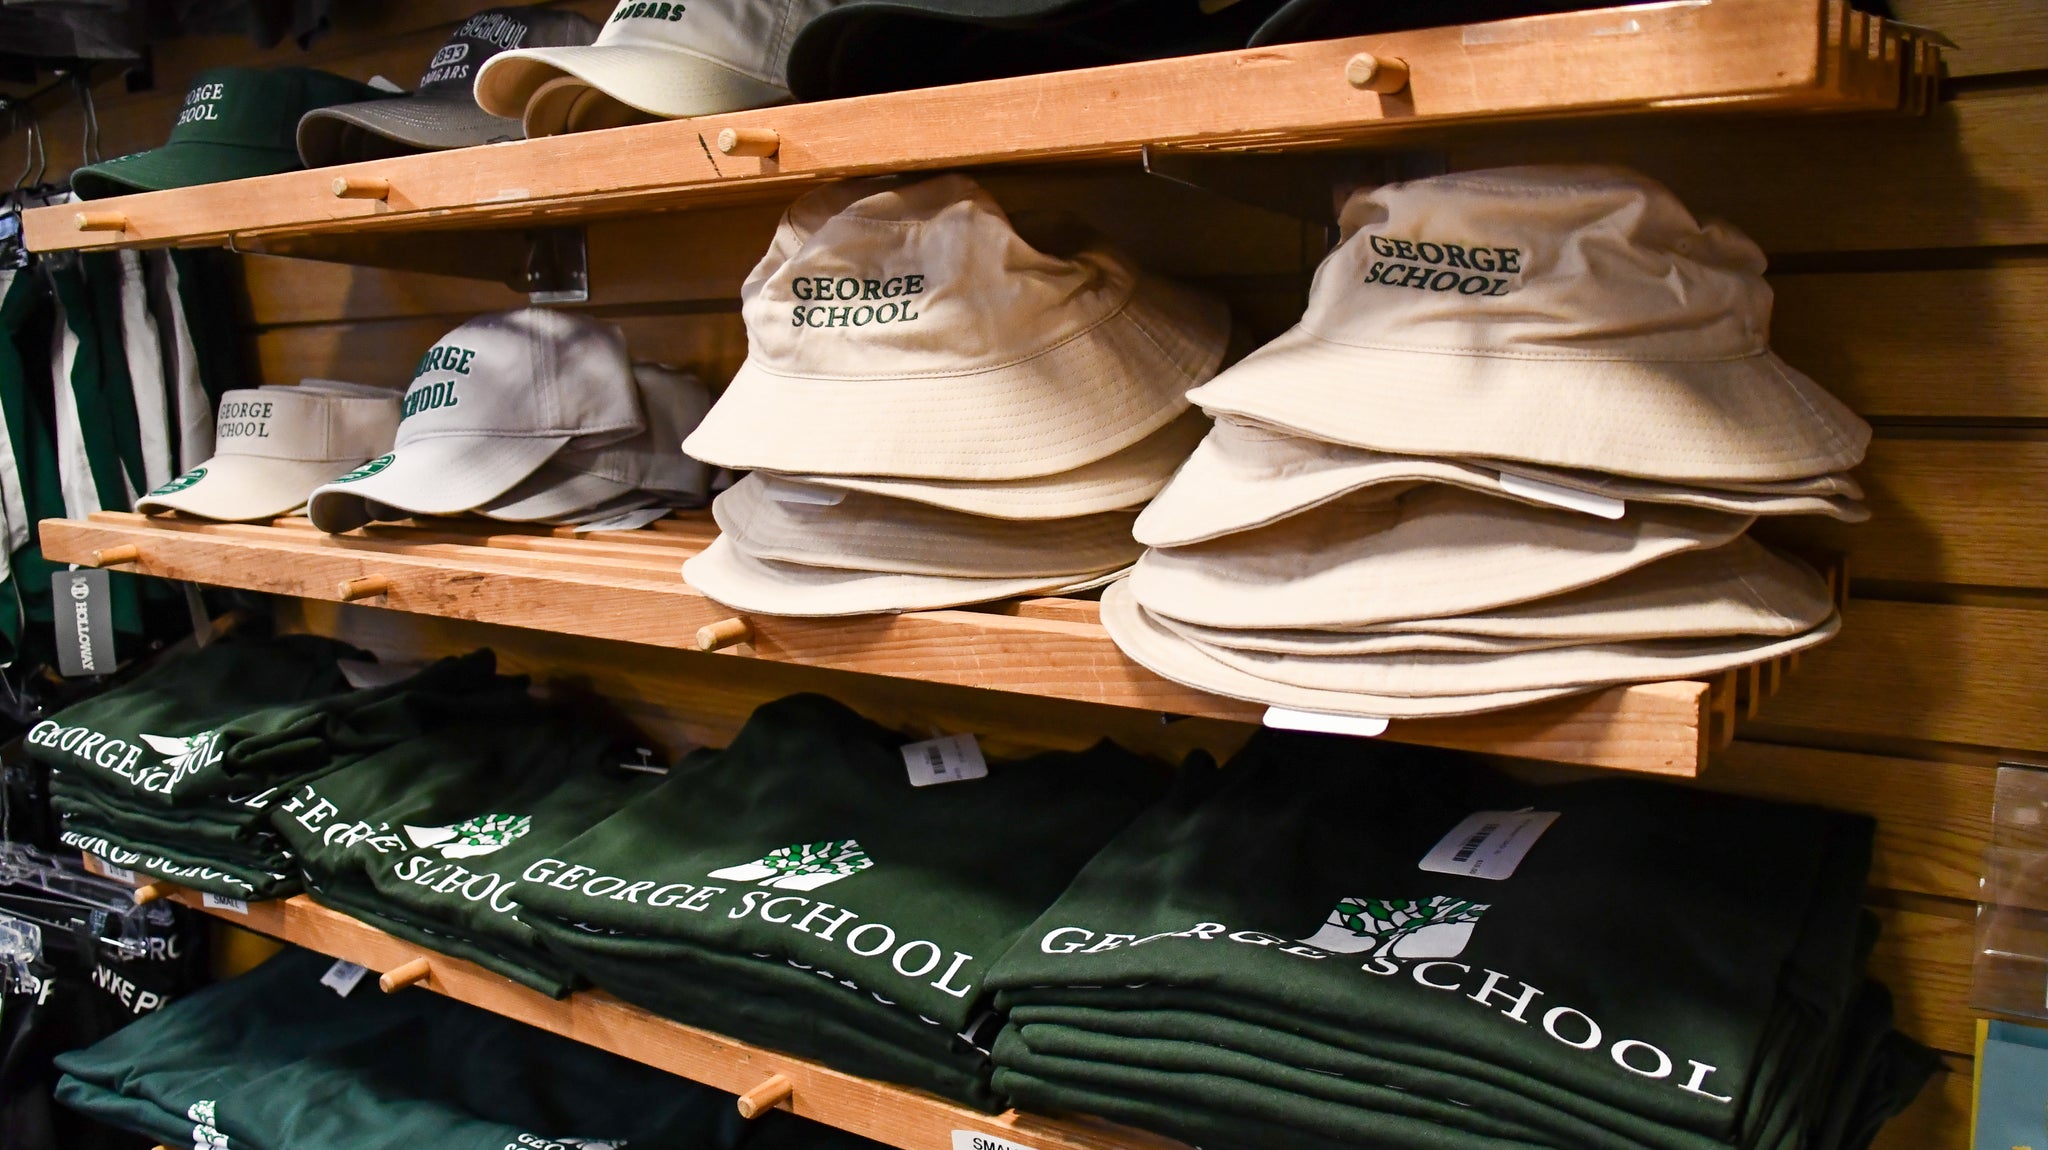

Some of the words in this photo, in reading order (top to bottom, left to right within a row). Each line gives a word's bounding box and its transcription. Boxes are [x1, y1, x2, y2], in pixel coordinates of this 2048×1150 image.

[185, 83, 224, 105] ORGE
[1370, 234, 1521, 274] GEORGE
[792, 274, 925, 301] GEORGE
[1364, 261, 1510, 297] SCHOOL
[792, 299, 919, 328] SCHOOL
[414, 345, 476, 378] ORGE
[219, 402, 273, 420] GEORGE
[75, 601, 95, 671] HOLLOWAY
[522, 858, 726, 912] GEORGE
[728, 891, 974, 998] SCHOOL
[1361, 956, 1734, 1103] SCHOOL
